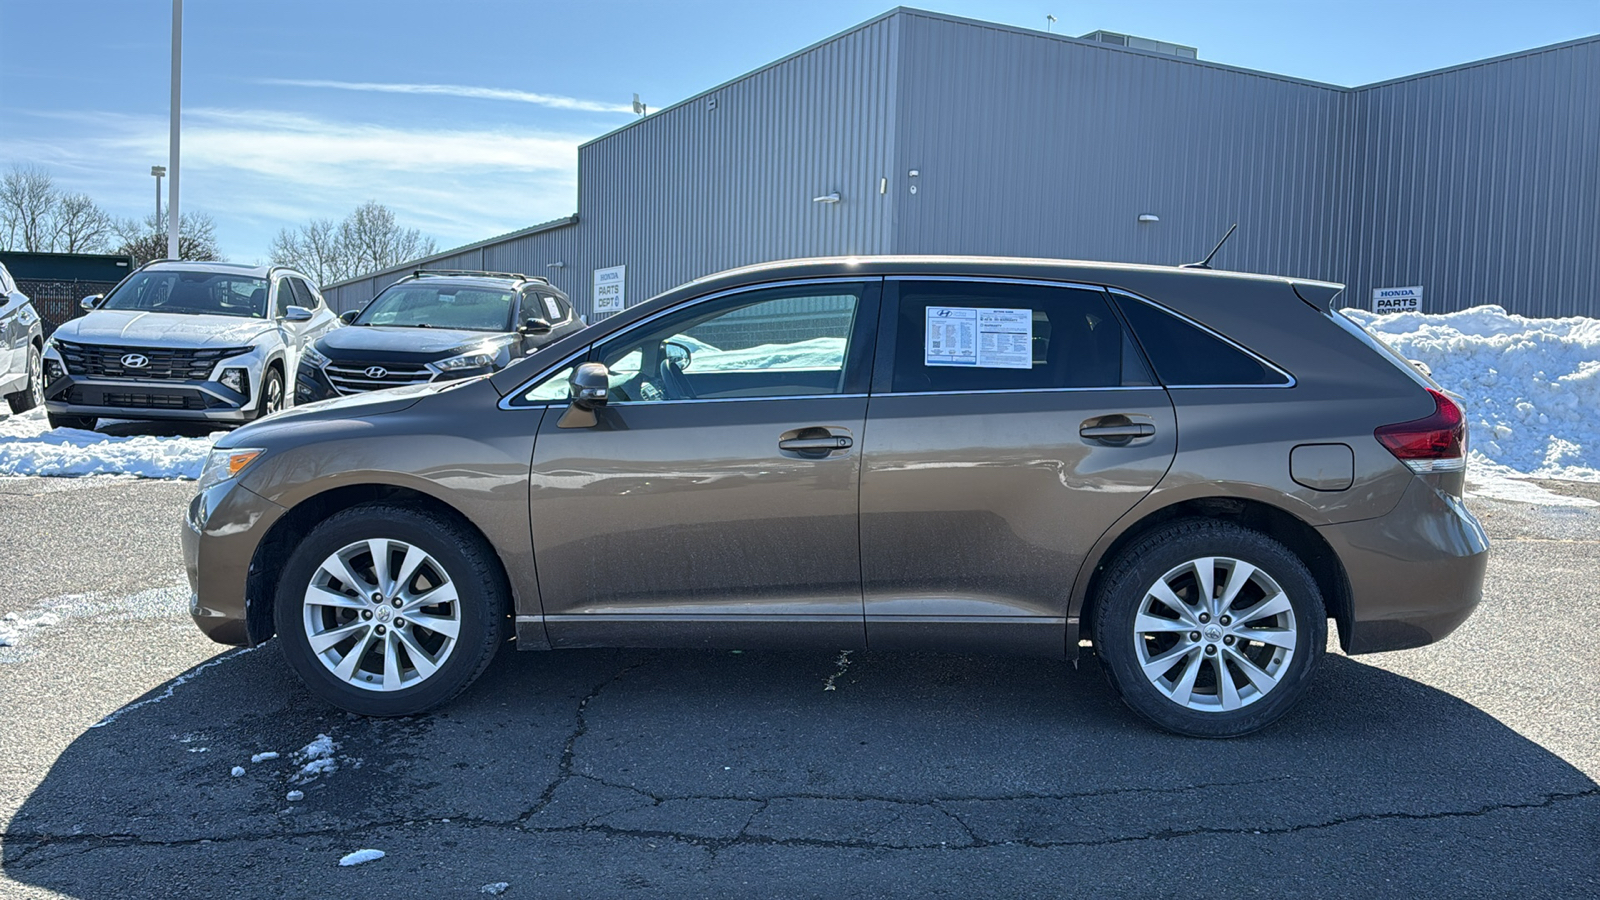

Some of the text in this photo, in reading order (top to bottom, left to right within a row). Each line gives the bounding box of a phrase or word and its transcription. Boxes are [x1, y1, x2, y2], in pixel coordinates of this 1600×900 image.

[600, 272, 619, 281] HONDA
[598, 285, 619, 296] PARTS
[1380, 289, 1415, 297] HONDA
[598, 297, 614, 308] DEPT
[1377, 298, 1417, 307] PARTS
